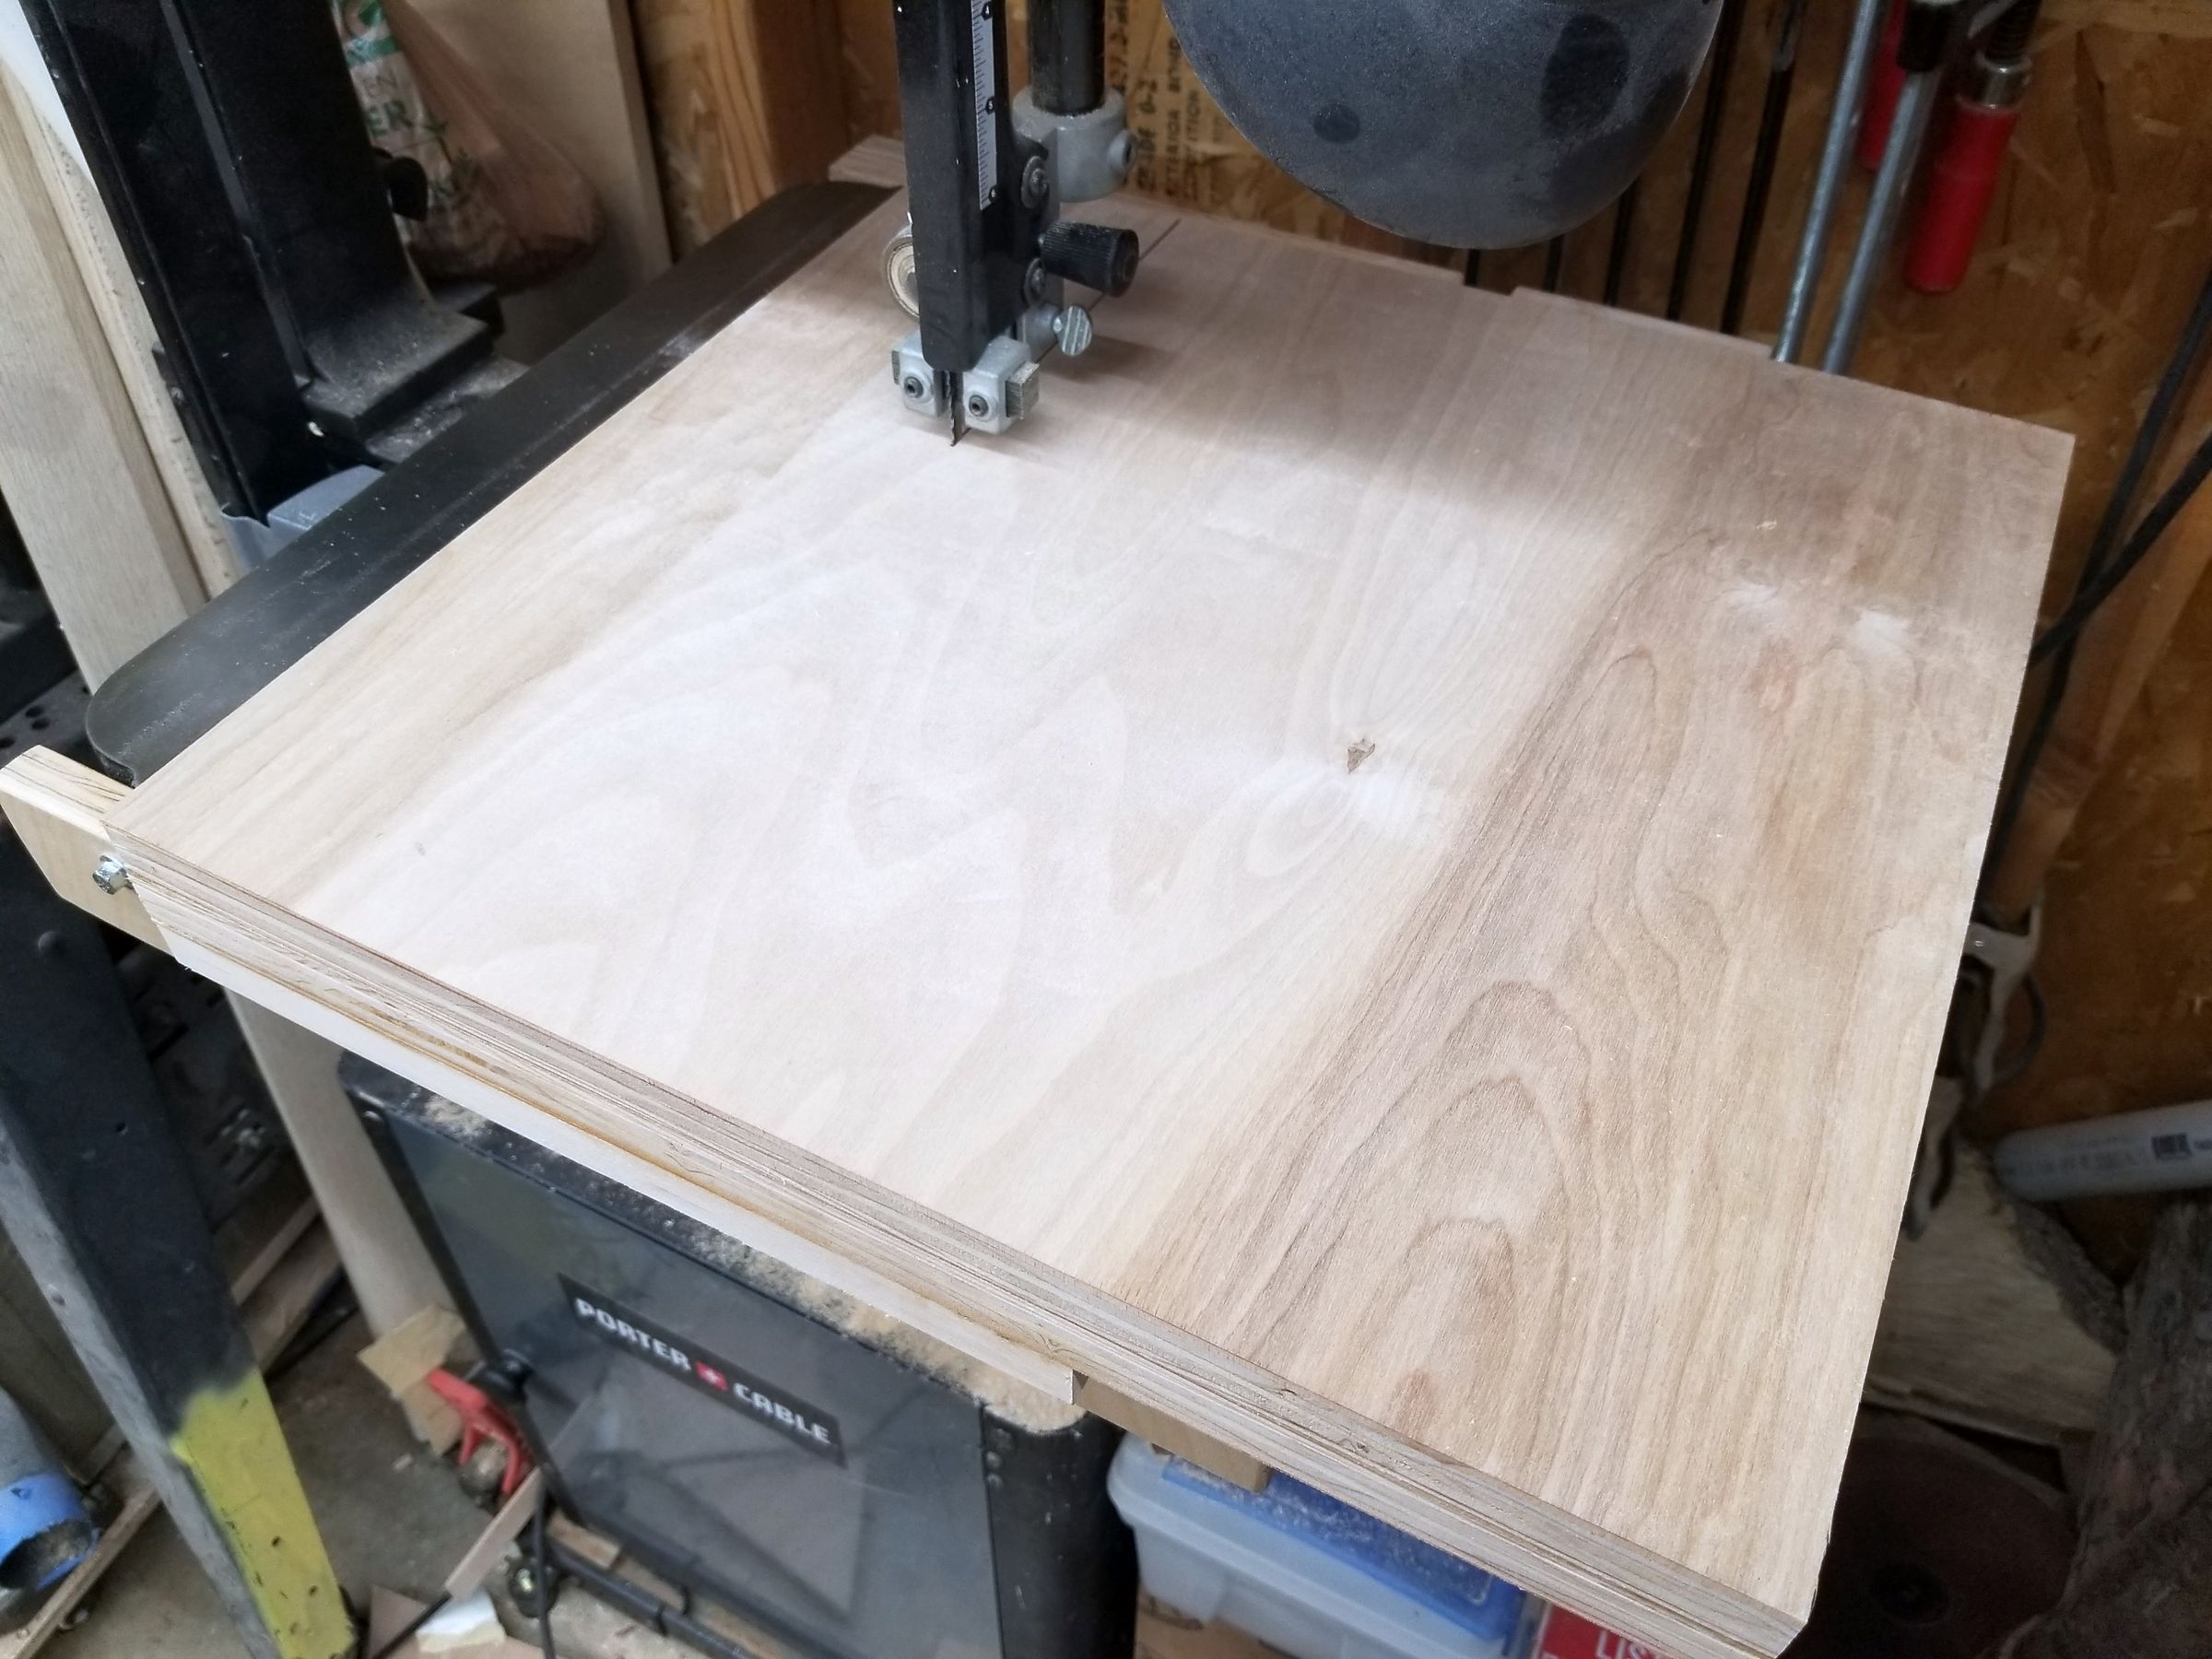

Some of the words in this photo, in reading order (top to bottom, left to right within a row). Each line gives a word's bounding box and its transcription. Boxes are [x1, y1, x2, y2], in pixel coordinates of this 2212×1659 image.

[984, 5, 990, 16] 4
[988, 100, 994, 110] 5
[574, 1297, 692, 1371] PORTER
[732, 1382, 831, 1444] CABLE
